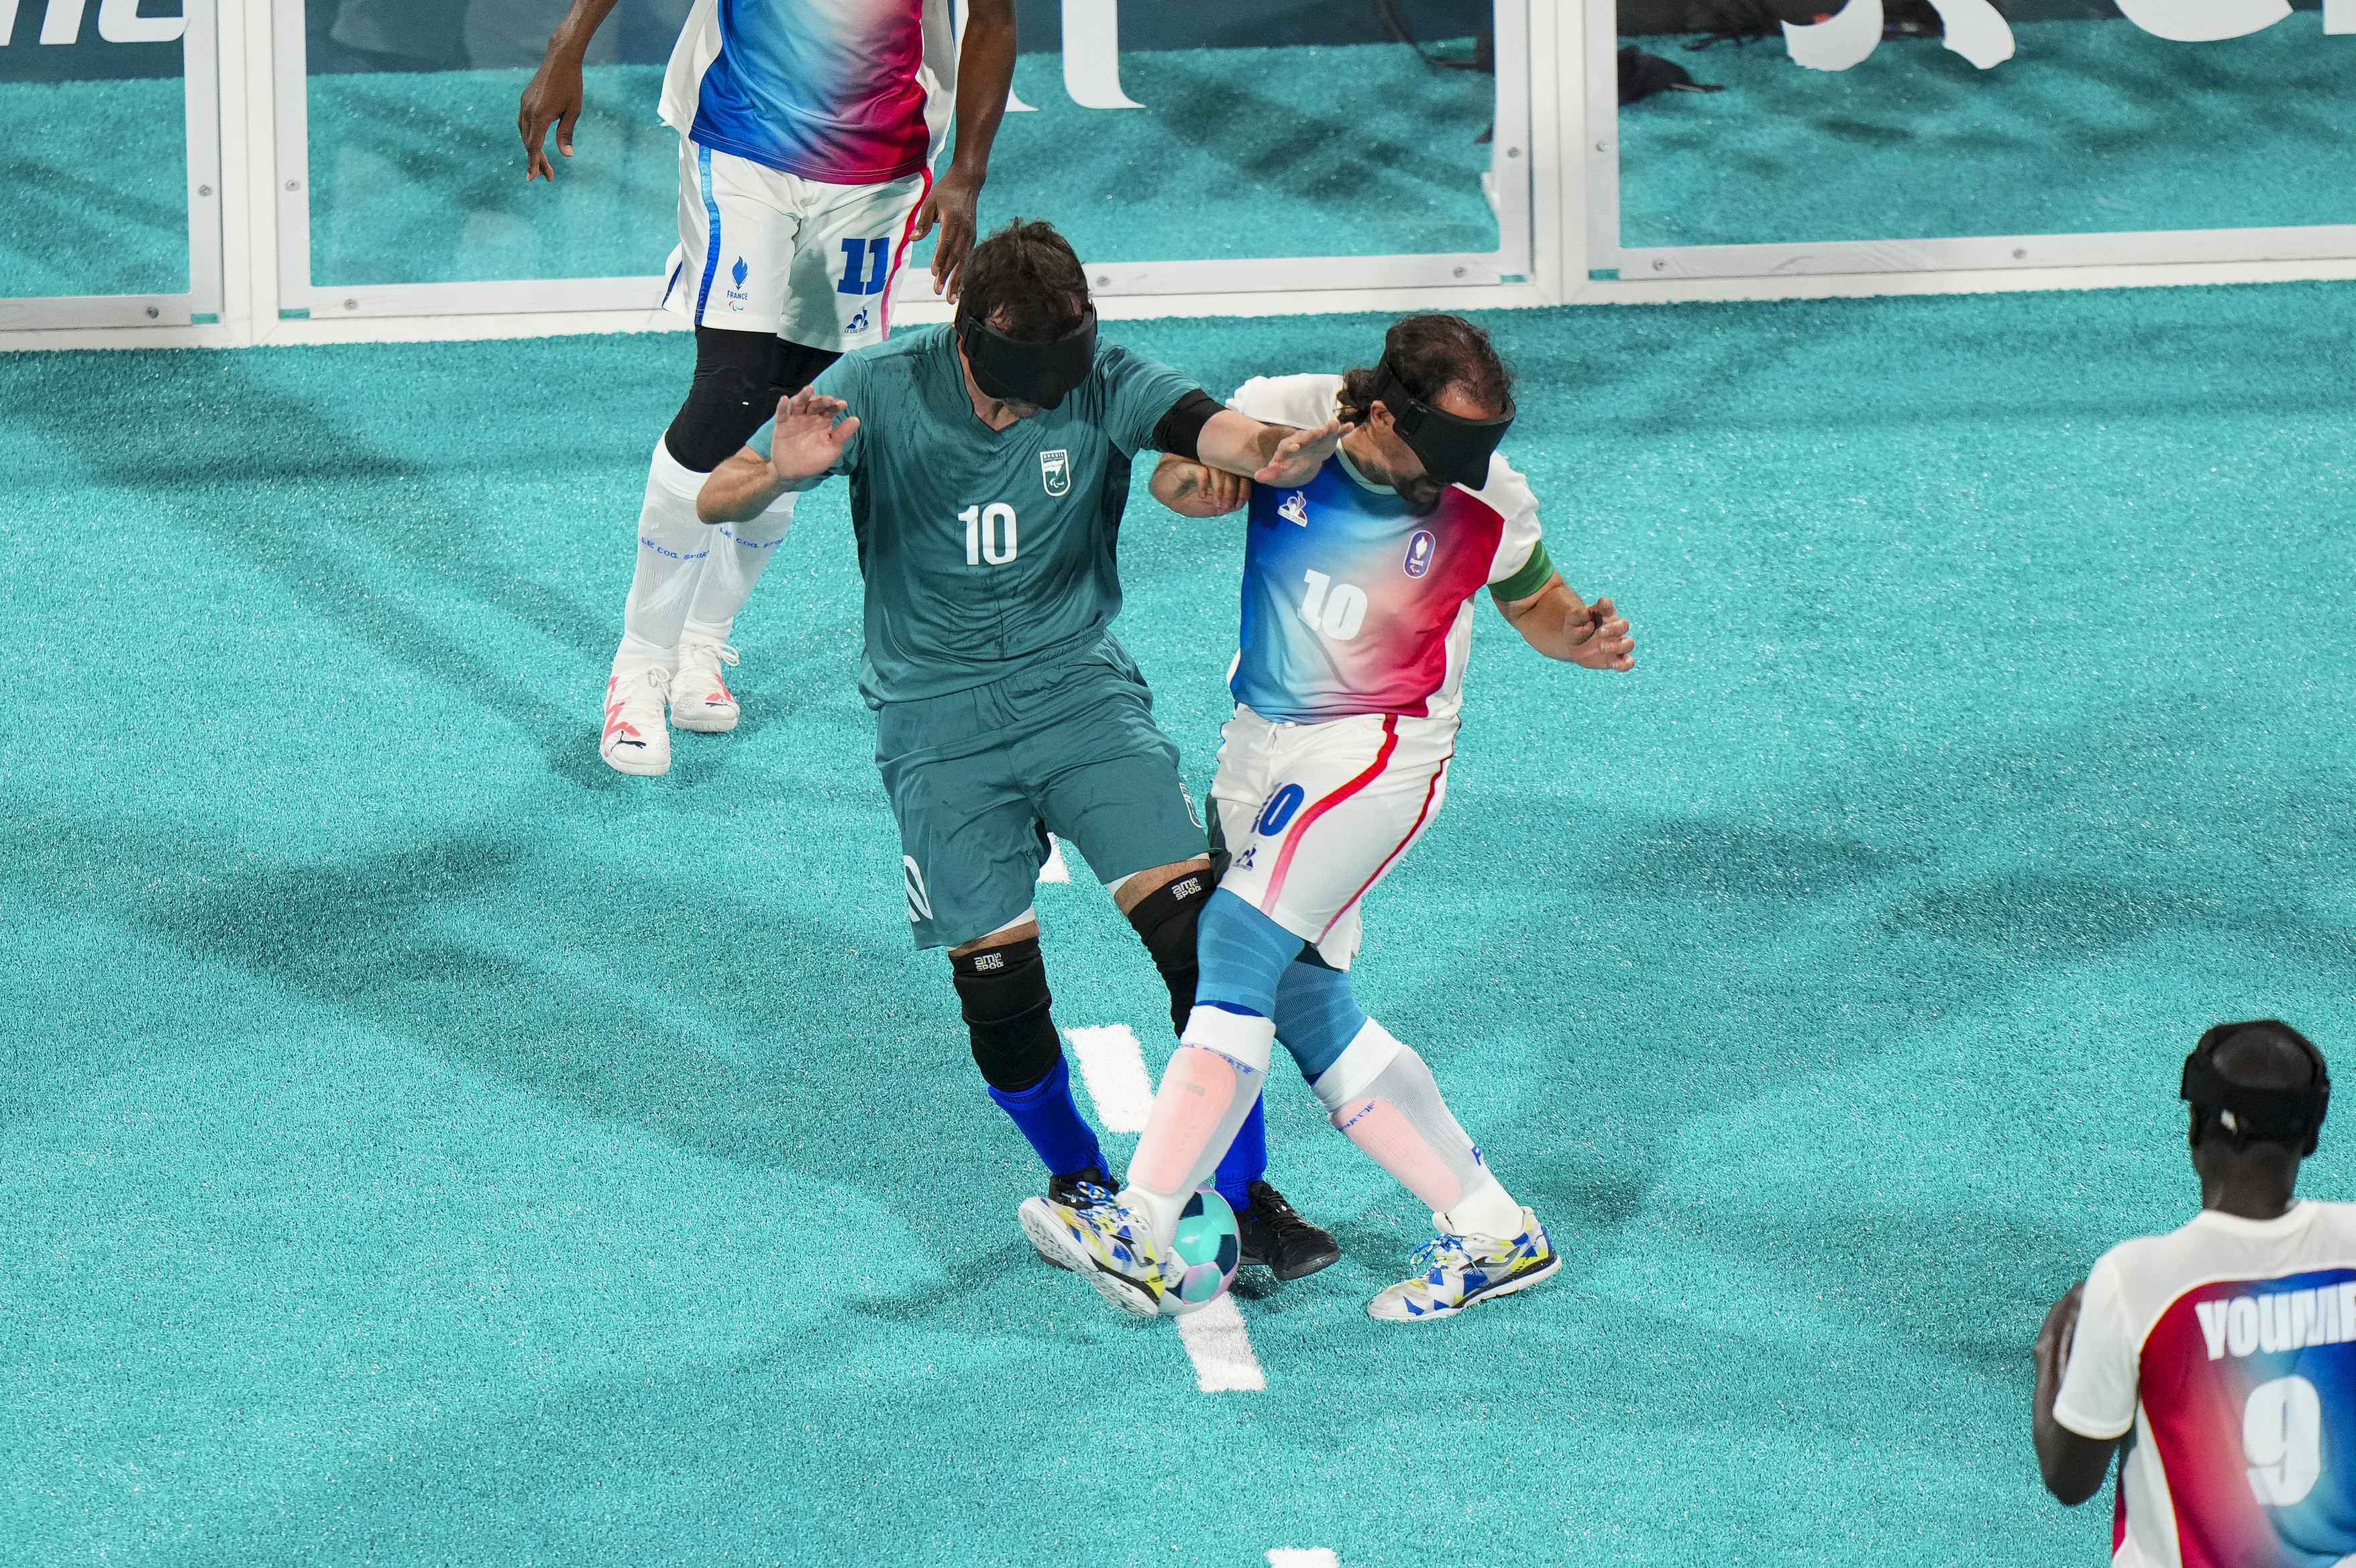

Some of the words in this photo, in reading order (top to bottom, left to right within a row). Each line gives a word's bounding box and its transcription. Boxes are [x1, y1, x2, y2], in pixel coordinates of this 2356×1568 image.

[727, 290, 749, 300] FRANCE
[837, 237, 890, 295] 11
[641, 537, 655, 549] LE
[657, 547, 678, 559] COQ
[720, 527, 733, 538] LE
[958, 502, 1018, 565] 10
[1296, 568, 1368, 640] 10
[2243, 1375, 2321, 1507] 9
